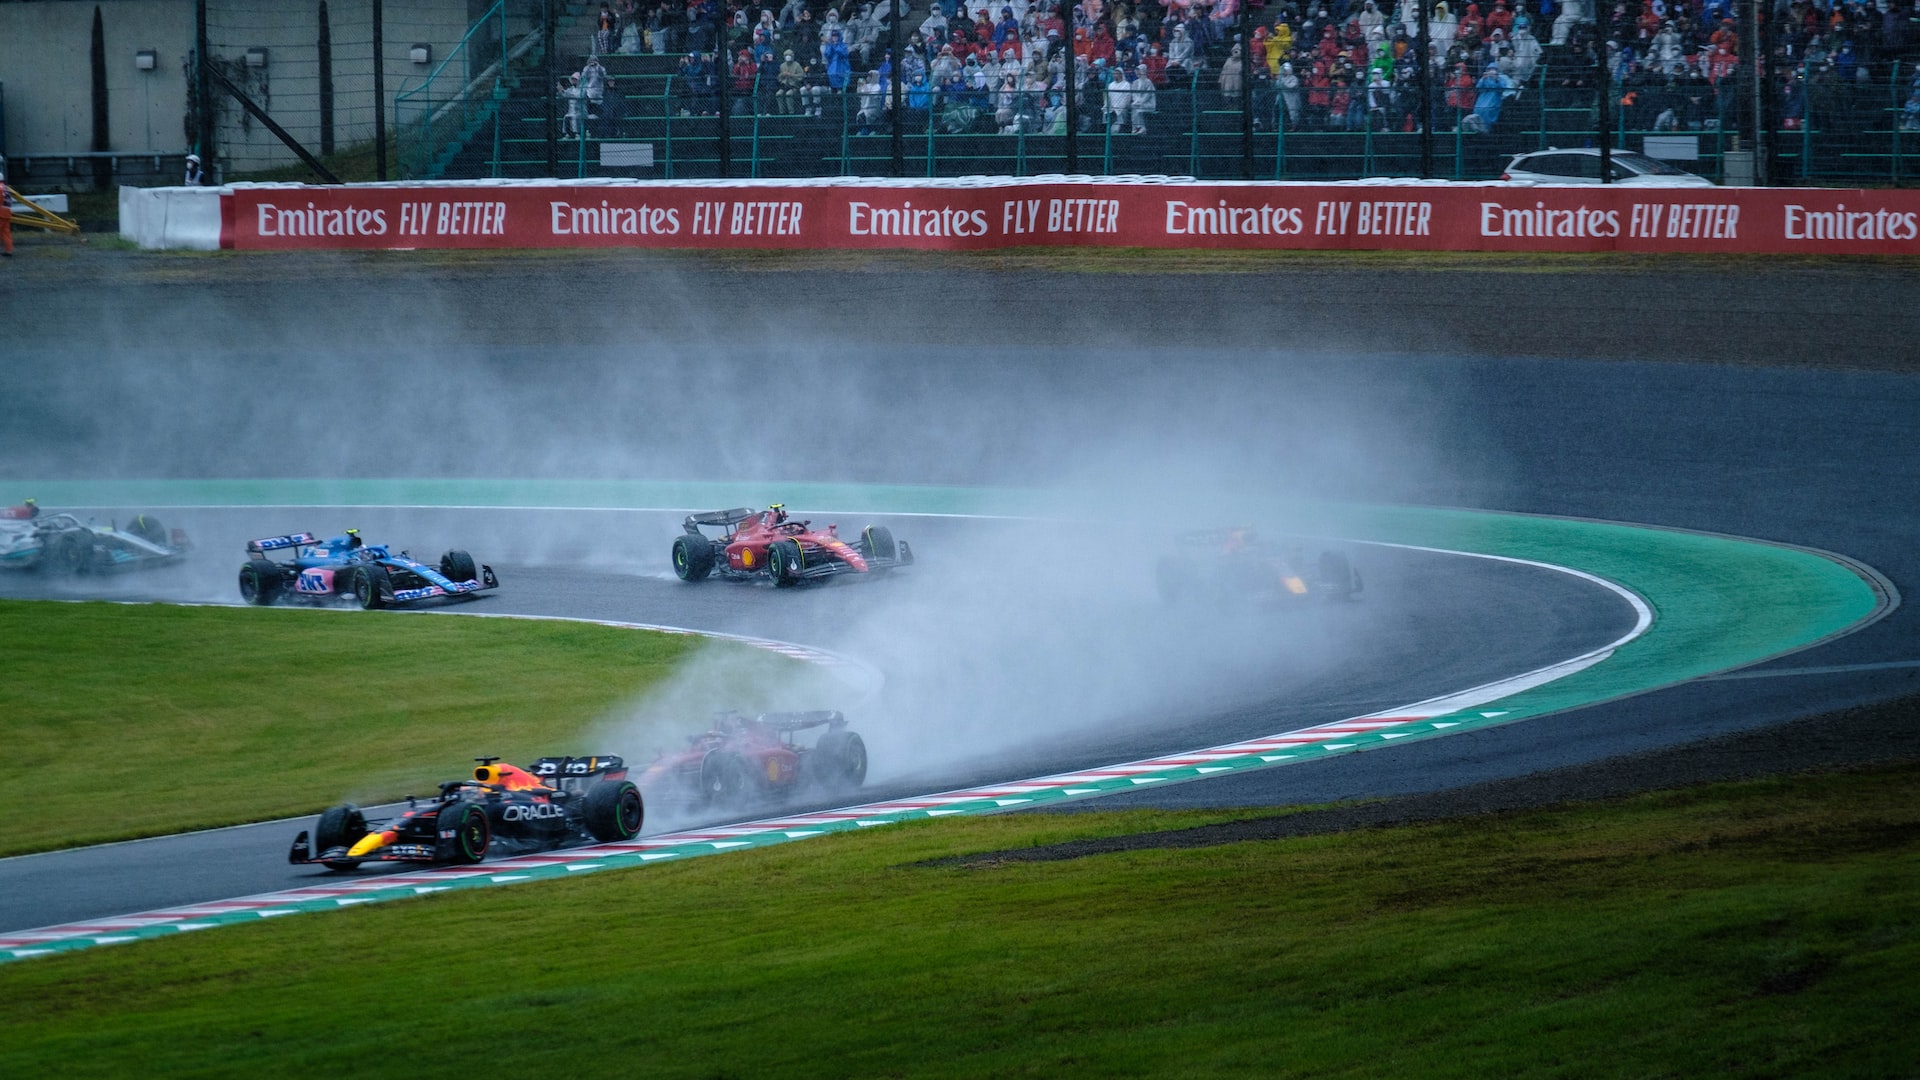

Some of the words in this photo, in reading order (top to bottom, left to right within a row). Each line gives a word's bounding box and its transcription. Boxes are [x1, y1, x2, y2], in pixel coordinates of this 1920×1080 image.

[256, 202, 387, 236] Emirates
[399, 202, 433, 235] FLY
[436, 202, 506, 235] BETTER
[550, 200, 680, 235] Emirates
[692, 202, 727, 235] FLY
[730, 202, 804, 235] BETTER
[848, 201, 988, 237] Emirates
[1003, 200, 1042, 235] FLY
[1047, 199, 1120, 232] BETTER
[1165, 200, 1303, 235] Emirates
[1314, 202, 1352, 235] FLY
[1357, 202, 1432, 235] BETTER
[1480, 202, 1620, 237] Emirates
[1629, 204, 1664, 238] FLY
[1667, 204, 1740, 239] BETTER
[1784, 204, 1917, 240] Emirates
[503, 804, 564, 821] ORACLE
